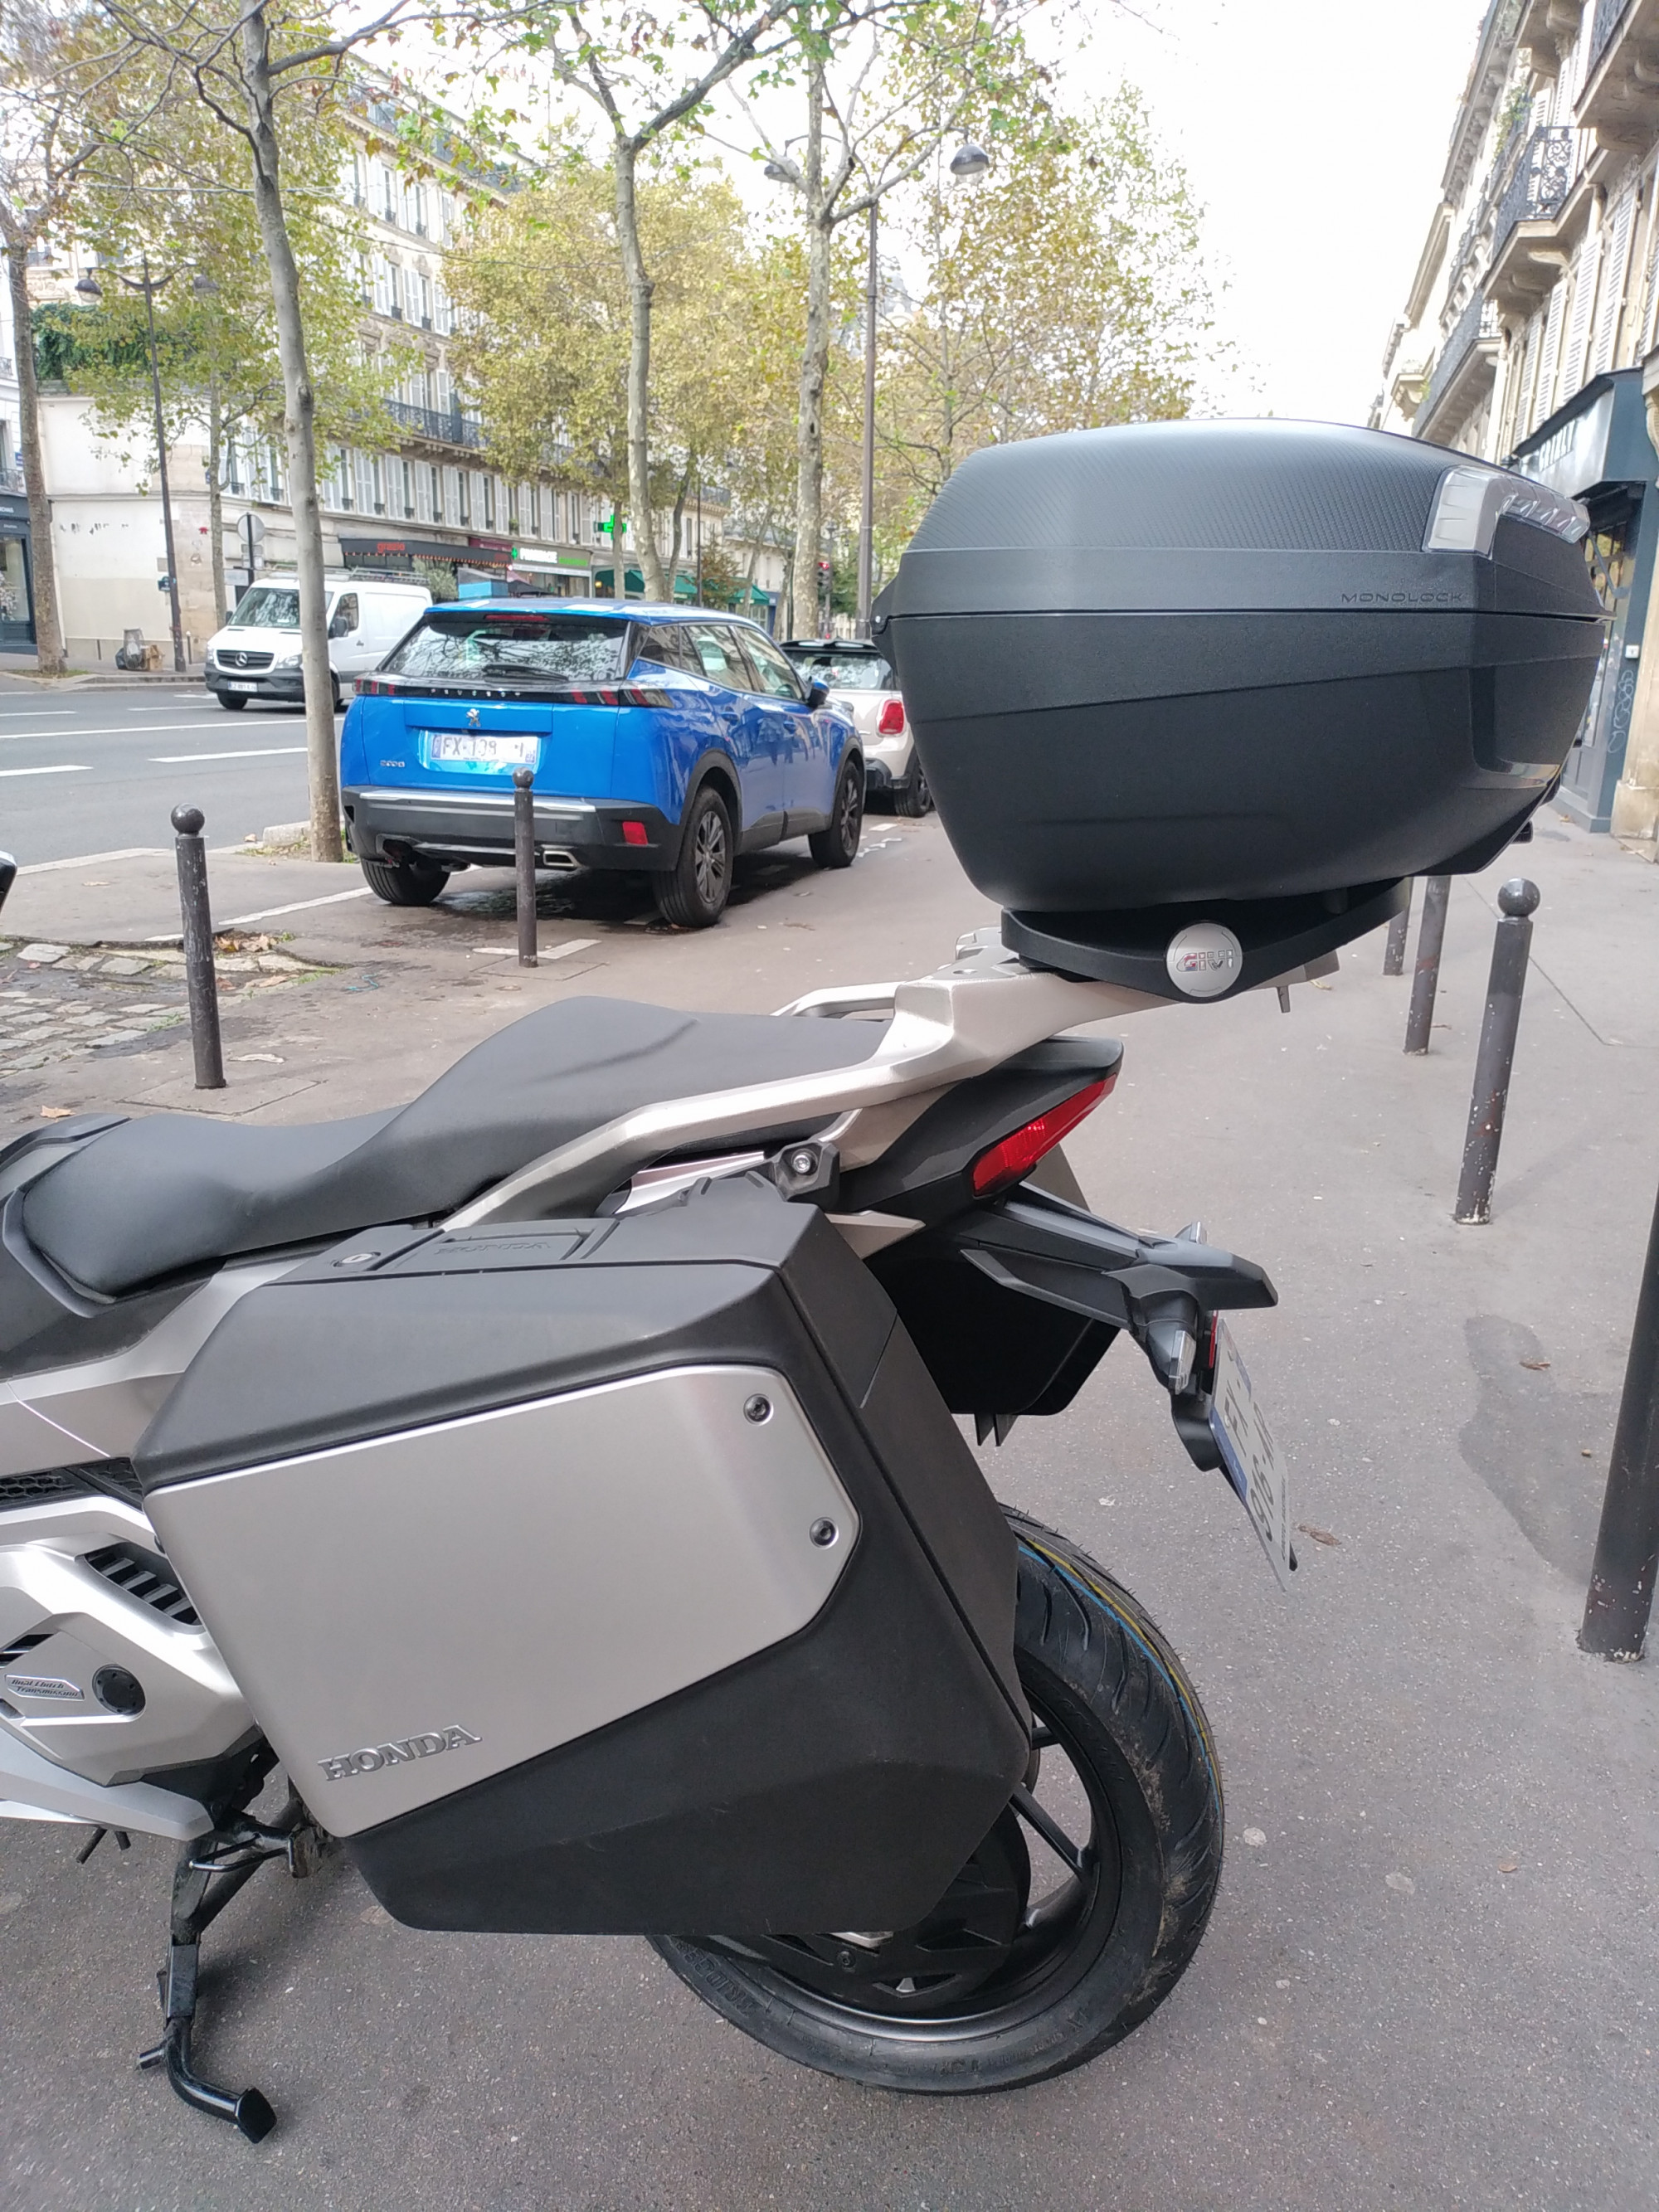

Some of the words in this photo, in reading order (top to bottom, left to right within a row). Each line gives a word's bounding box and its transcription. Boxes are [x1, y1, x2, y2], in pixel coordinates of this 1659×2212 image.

[1340, 592, 1463, 604] MONOLOCK
[1175, 949, 1234, 973] GIVI
[16, 1686, 79, 1697] Transmission
[317, 1724, 484, 1782] HONDA
